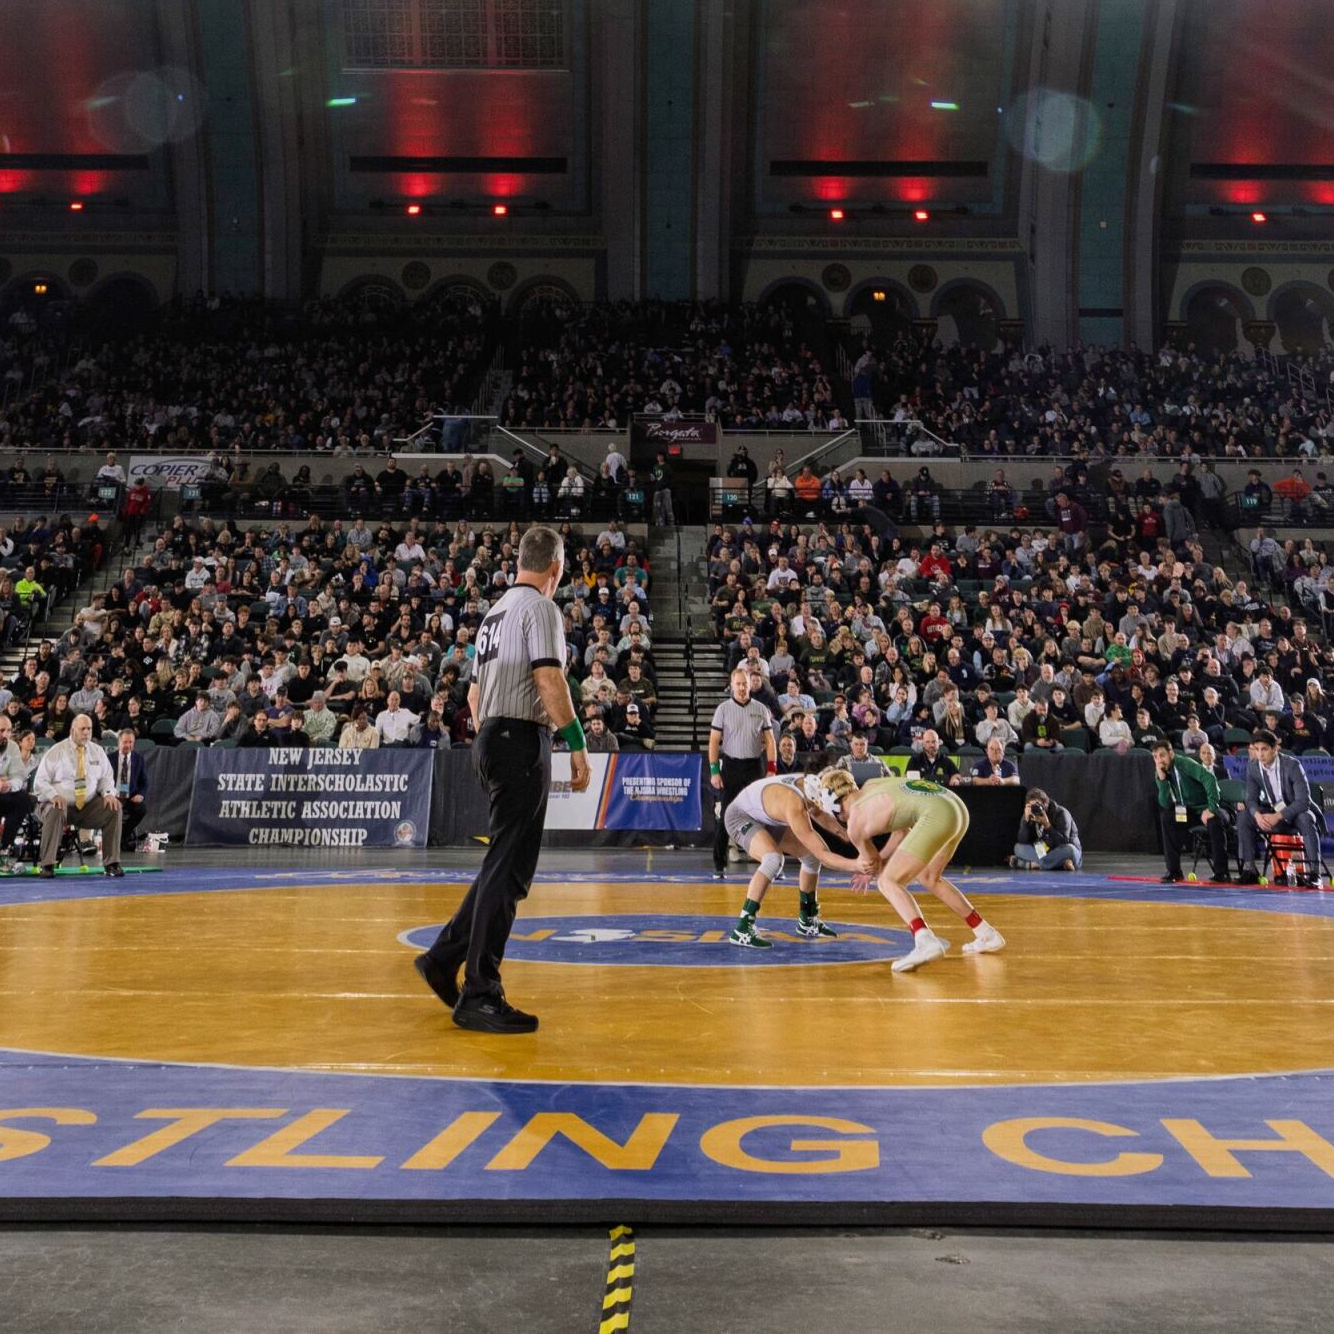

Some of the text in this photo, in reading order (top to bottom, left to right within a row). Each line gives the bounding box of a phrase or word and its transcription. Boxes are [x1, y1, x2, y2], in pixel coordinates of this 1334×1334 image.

[165, 476, 199, 485] PLU
[478, 619, 503, 655] 614
[268, 747, 364, 770] NEW JERSEY
[217, 773, 409, 793] STATE INTERSCHOLASTIC
[656, 777, 681, 787] SPONSOR
[219, 800, 401, 819] ATHLETIC ASSOCIATION
[248, 827, 368, 847] CHAMPIONSHIP
